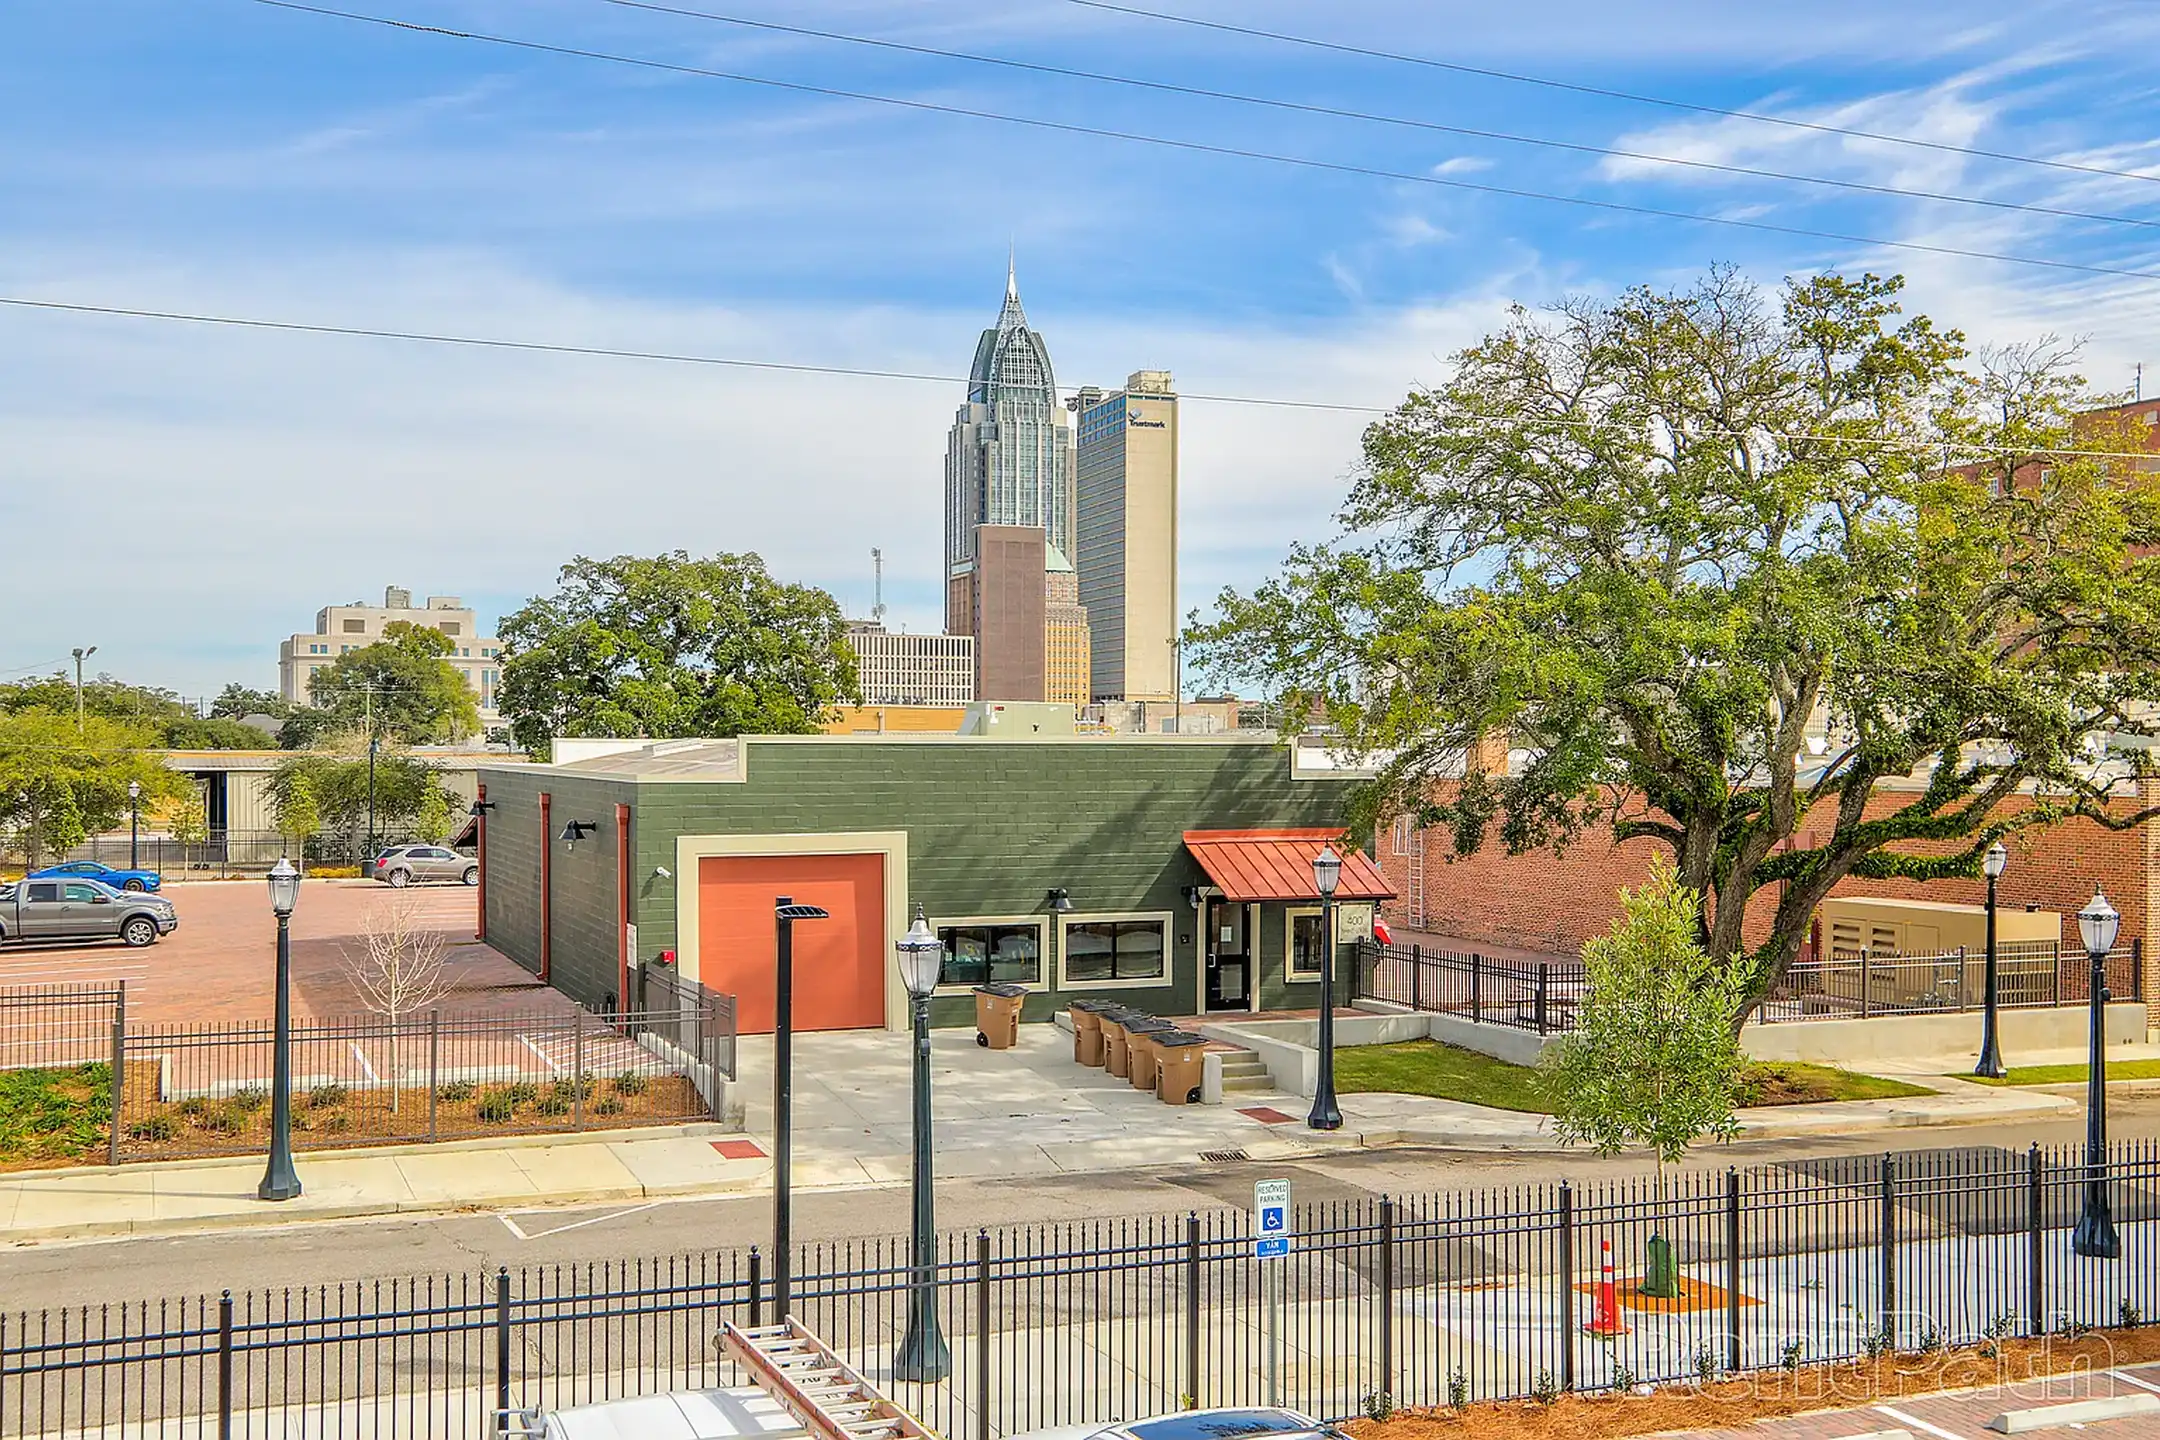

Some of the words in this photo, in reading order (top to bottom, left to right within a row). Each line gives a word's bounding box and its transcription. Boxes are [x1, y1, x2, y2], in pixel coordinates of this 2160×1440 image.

[1128, 419, 1166, 428] Trustmark
[1258, 1184, 1287, 1194] RESERVED
[1260, 1194, 1286, 1204] PARKING
